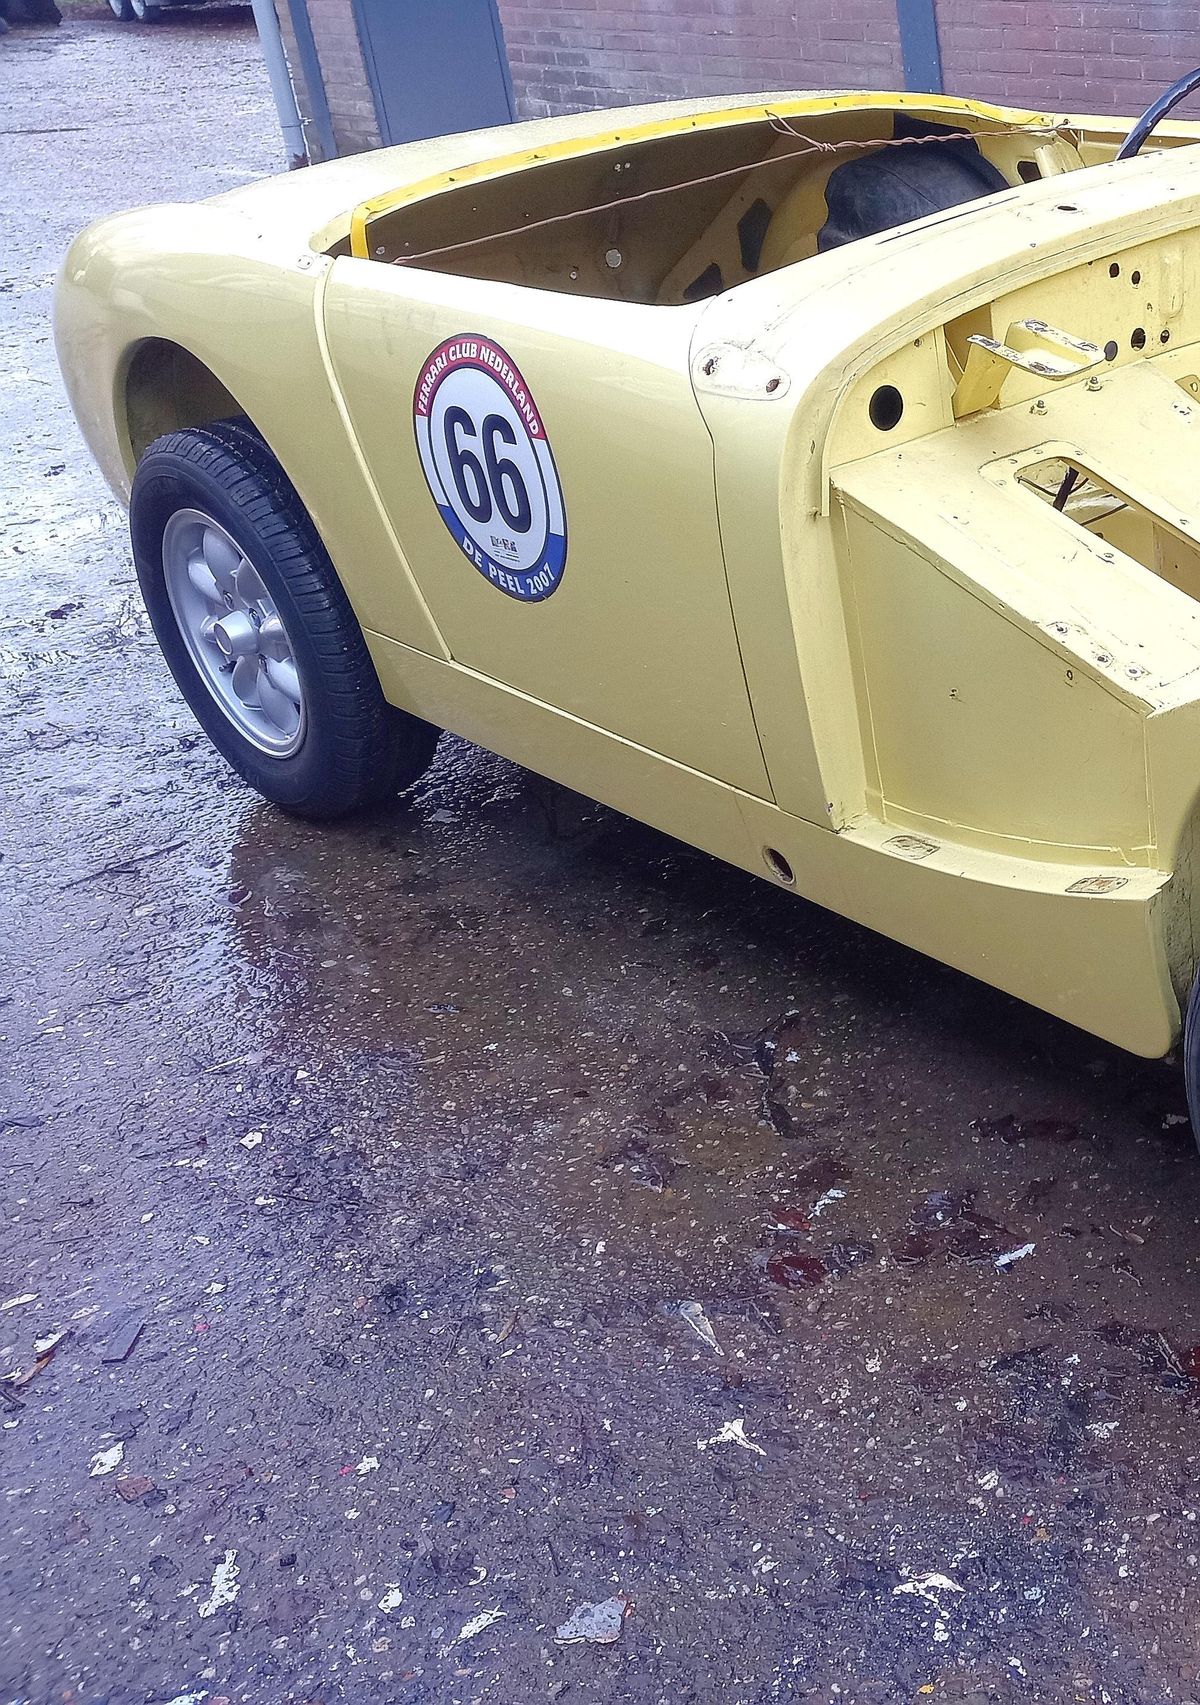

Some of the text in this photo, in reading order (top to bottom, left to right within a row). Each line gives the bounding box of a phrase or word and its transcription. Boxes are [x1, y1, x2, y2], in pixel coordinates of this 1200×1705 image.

[418, 342, 539, 435] FERRARI CLUB NEDERLAND
[443, 405, 532, 534] 66
[462, 536, 484, 568] DE
[488, 562, 526, 595] PEEL
[526, 562, 556, 595] 2007
